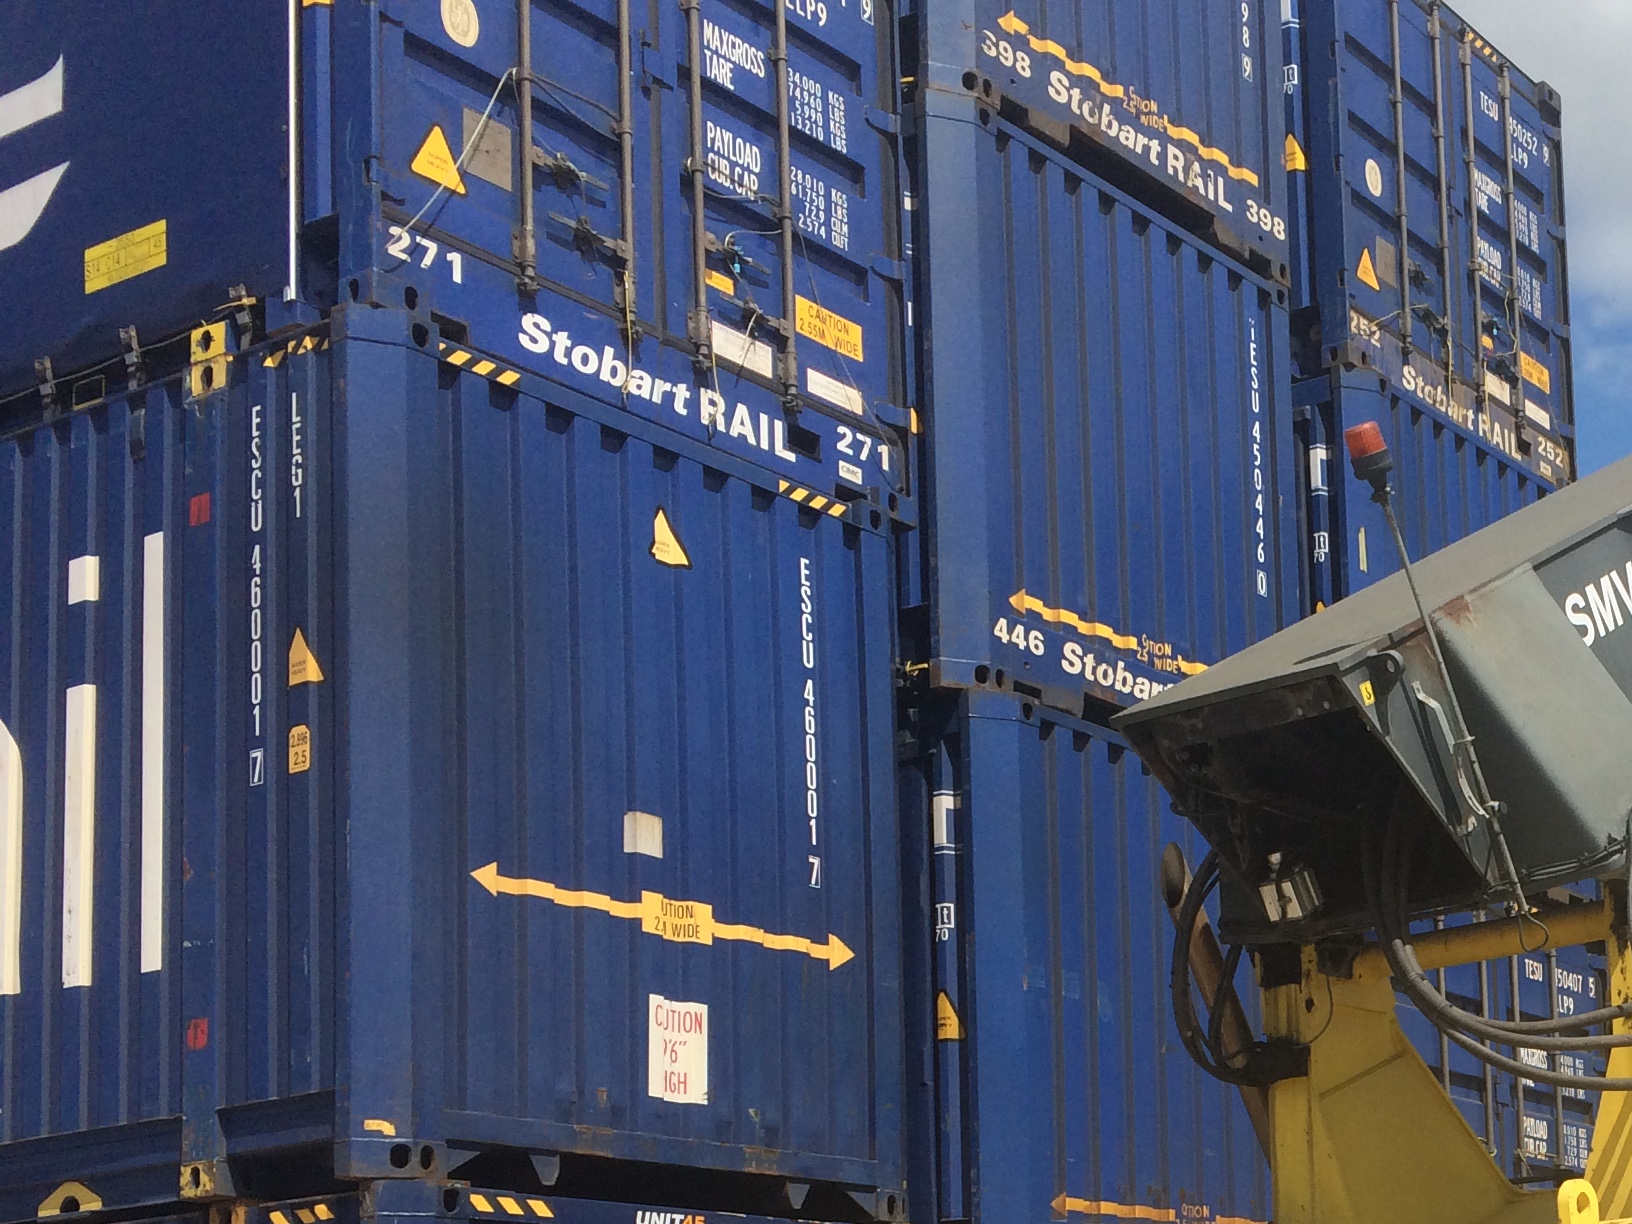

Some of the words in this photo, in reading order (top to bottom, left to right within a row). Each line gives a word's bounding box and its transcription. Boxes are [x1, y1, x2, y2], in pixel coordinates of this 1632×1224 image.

[703, 18, 765, 78] MAXGROSS
[1243, 55, 1251, 79] 9
[704, 49, 735, 91] TARE
[788, 67, 822, 97] 34.000
[828, 91, 845, 111] KGS
[789, 82, 822, 112] 74.960
[829, 105, 846, 125] LBS
[795, 101, 823, 126] 5.990
[829, 121, 847, 139] KGS
[706, 121, 761, 174] PAYLOAD
[791, 112, 824, 142] 13.210
[830, 134, 847, 154] LBS
[981, 29, 1032, 79] 398
[1047, 69, 1162, 166] Stobart
[1166, 142, 1234, 213] RAIL
[1246, 198, 1286, 241] 398
[1479, 90, 1499, 122] TESU
[1543, 143, 1550, 166] 9
[790, 166, 824, 196] 28.010
[830, 187, 848, 205] KGS
[790, 182, 825, 210] 61.750
[831, 203, 848, 223] LBS
[798, 214, 826, 240] 2.574
[804, 202, 825, 223] 72.9
[387, 226, 462, 284] 271
[799, 317, 826, 341] 2.55M
[833, 336, 859, 357] WIDE
[808, 304, 850, 335] CAUTION
[518, 312, 691, 416] Stobart
[699, 386, 797, 463] RAIL
[1350, 310, 1381, 348] 252
[1402, 363, 1475, 431] Stobart
[1478, 412, 1522, 461] RAIL
[1537, 436, 1564, 469] 252
[251, 404, 262, 532] ESCU
[836, 425, 890, 471] 271
[1252, 421, 1265, 564] 450446
[1258, 571, 1266, 596] 0
[799, 557, 814, 669] ESCU
[251, 544, 262, 737] 460001
[993, 616, 1045, 657] 446
[1061, 641, 1177, 700] Stobar
[250, 750, 262, 785] 7
[293, 750, 307, 766] 2.5
[804, 678, 817, 846] 460001
[808, 856, 820, 887] 7
[671, 923, 701, 939] WIDE
[936, 928, 949, 942] 70
[1524, 958, 1543, 982] TESU
[1589, 977, 1597, 998] 5
[1556, 994, 1574, 1015] LP9
